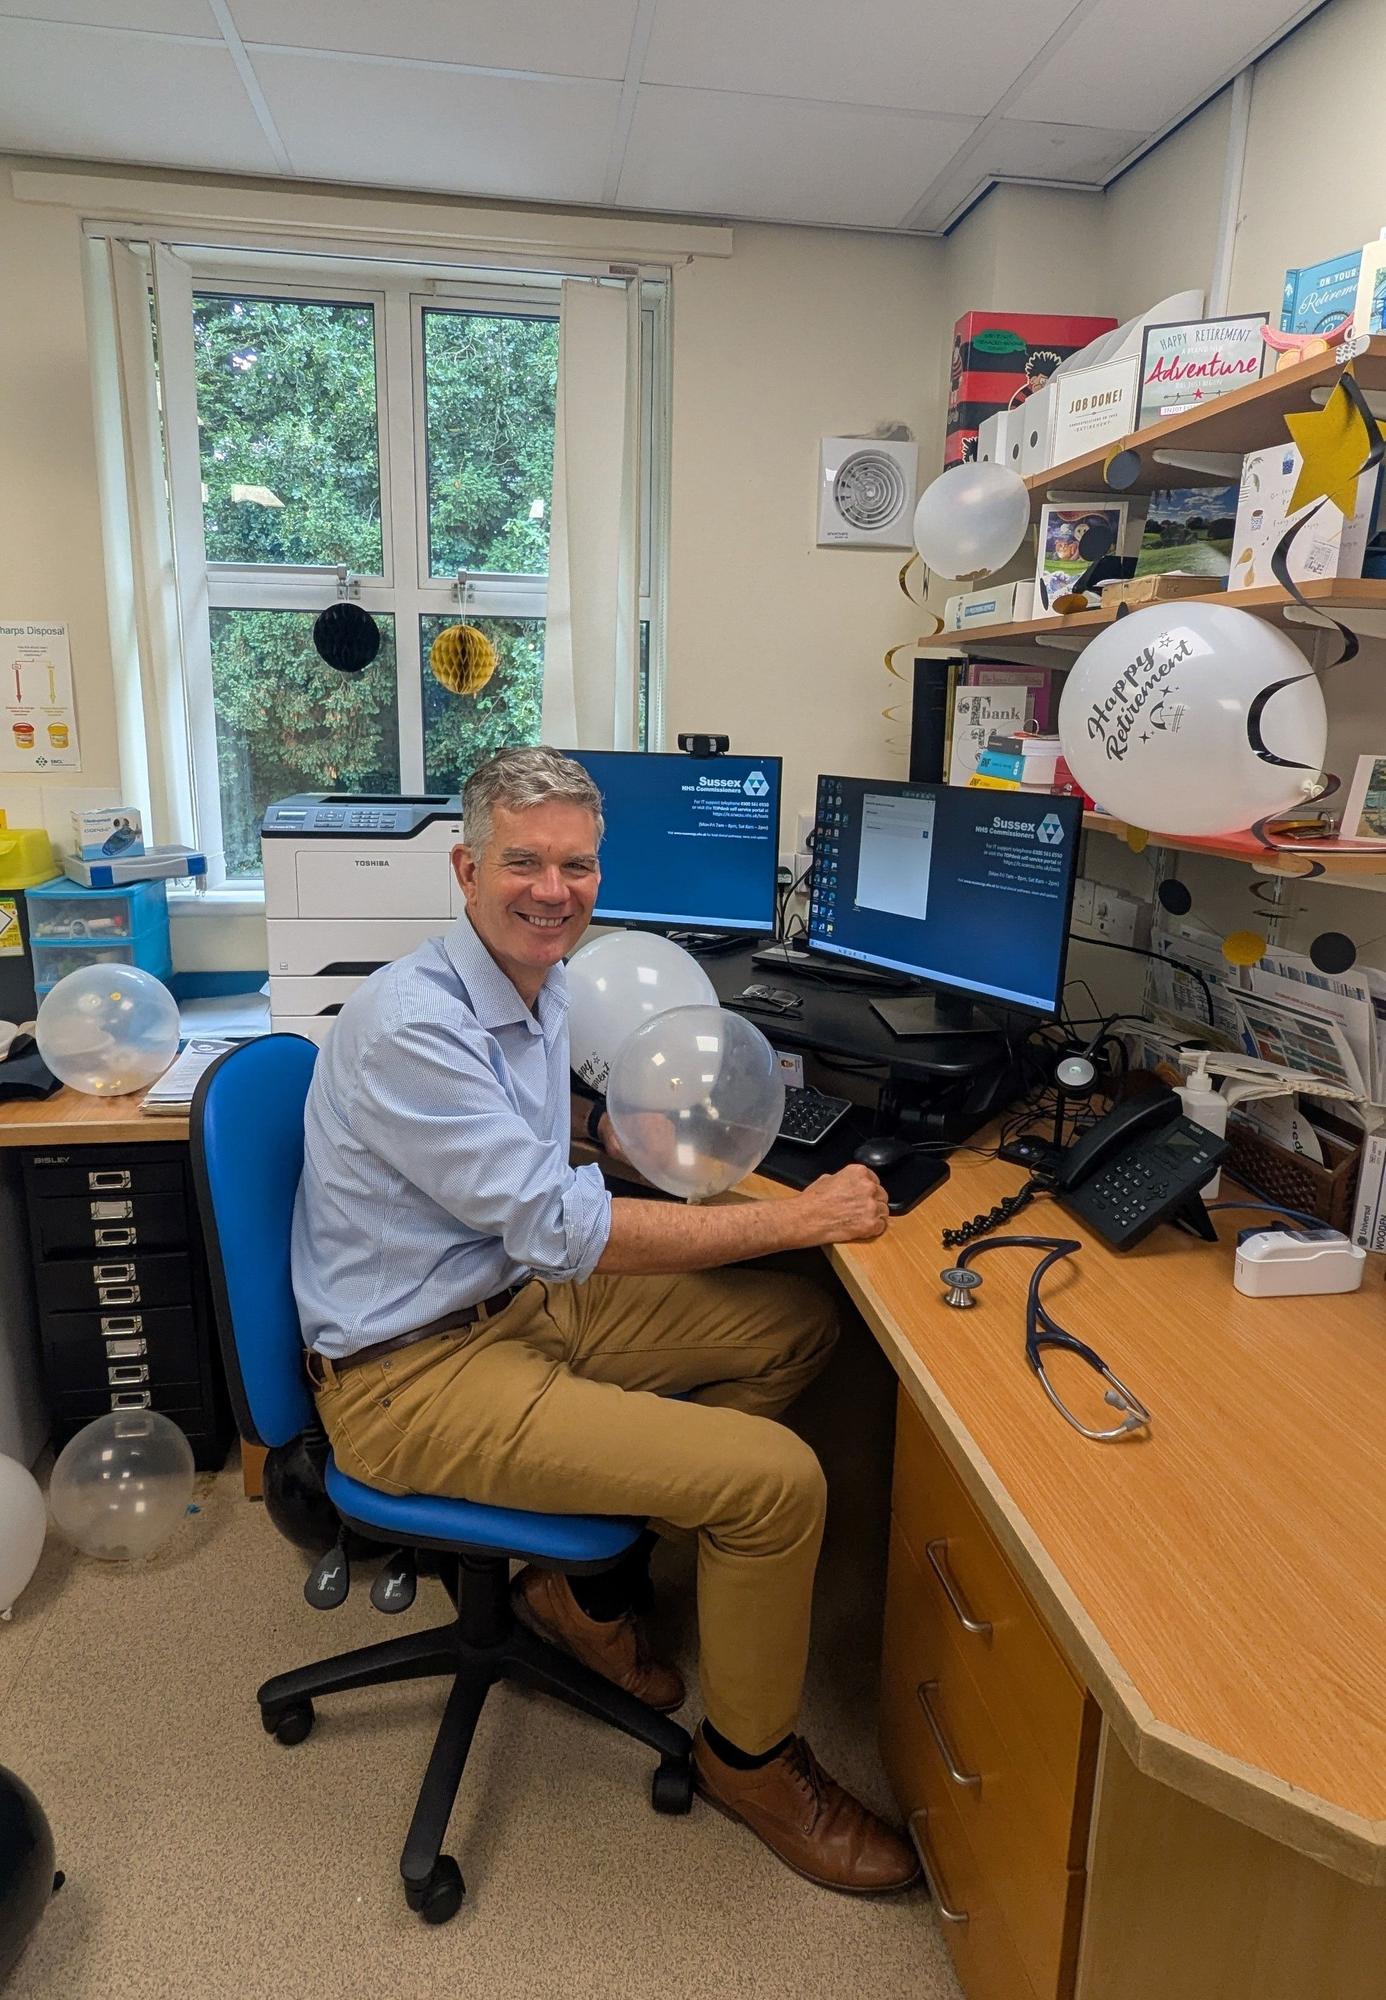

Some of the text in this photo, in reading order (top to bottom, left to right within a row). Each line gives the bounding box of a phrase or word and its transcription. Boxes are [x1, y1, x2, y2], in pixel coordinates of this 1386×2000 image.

[1319, 277, 1331, 287] ON
[1160, 327, 1252, 351] HAPPY RETIREMENT
[1145, 351, 1258, 385] Adventure
[1069, 388, 1123, 414] JOB DONE!
[27, 626, 65, 637] Disposal
[1087, 646, 1155, 742] Happy
[1106, 639, 1194, 761] Retirement
[696, 785, 741, 794] Commissioners
[699, 776, 741, 788] Sussex
[992, 816, 1036, 832] Sussex
[975, 825, 1035, 840] NHS Commissioners
[34, 1156, 70, 1164] BISLEY
[1359, 1205, 1372, 1236] Universal
